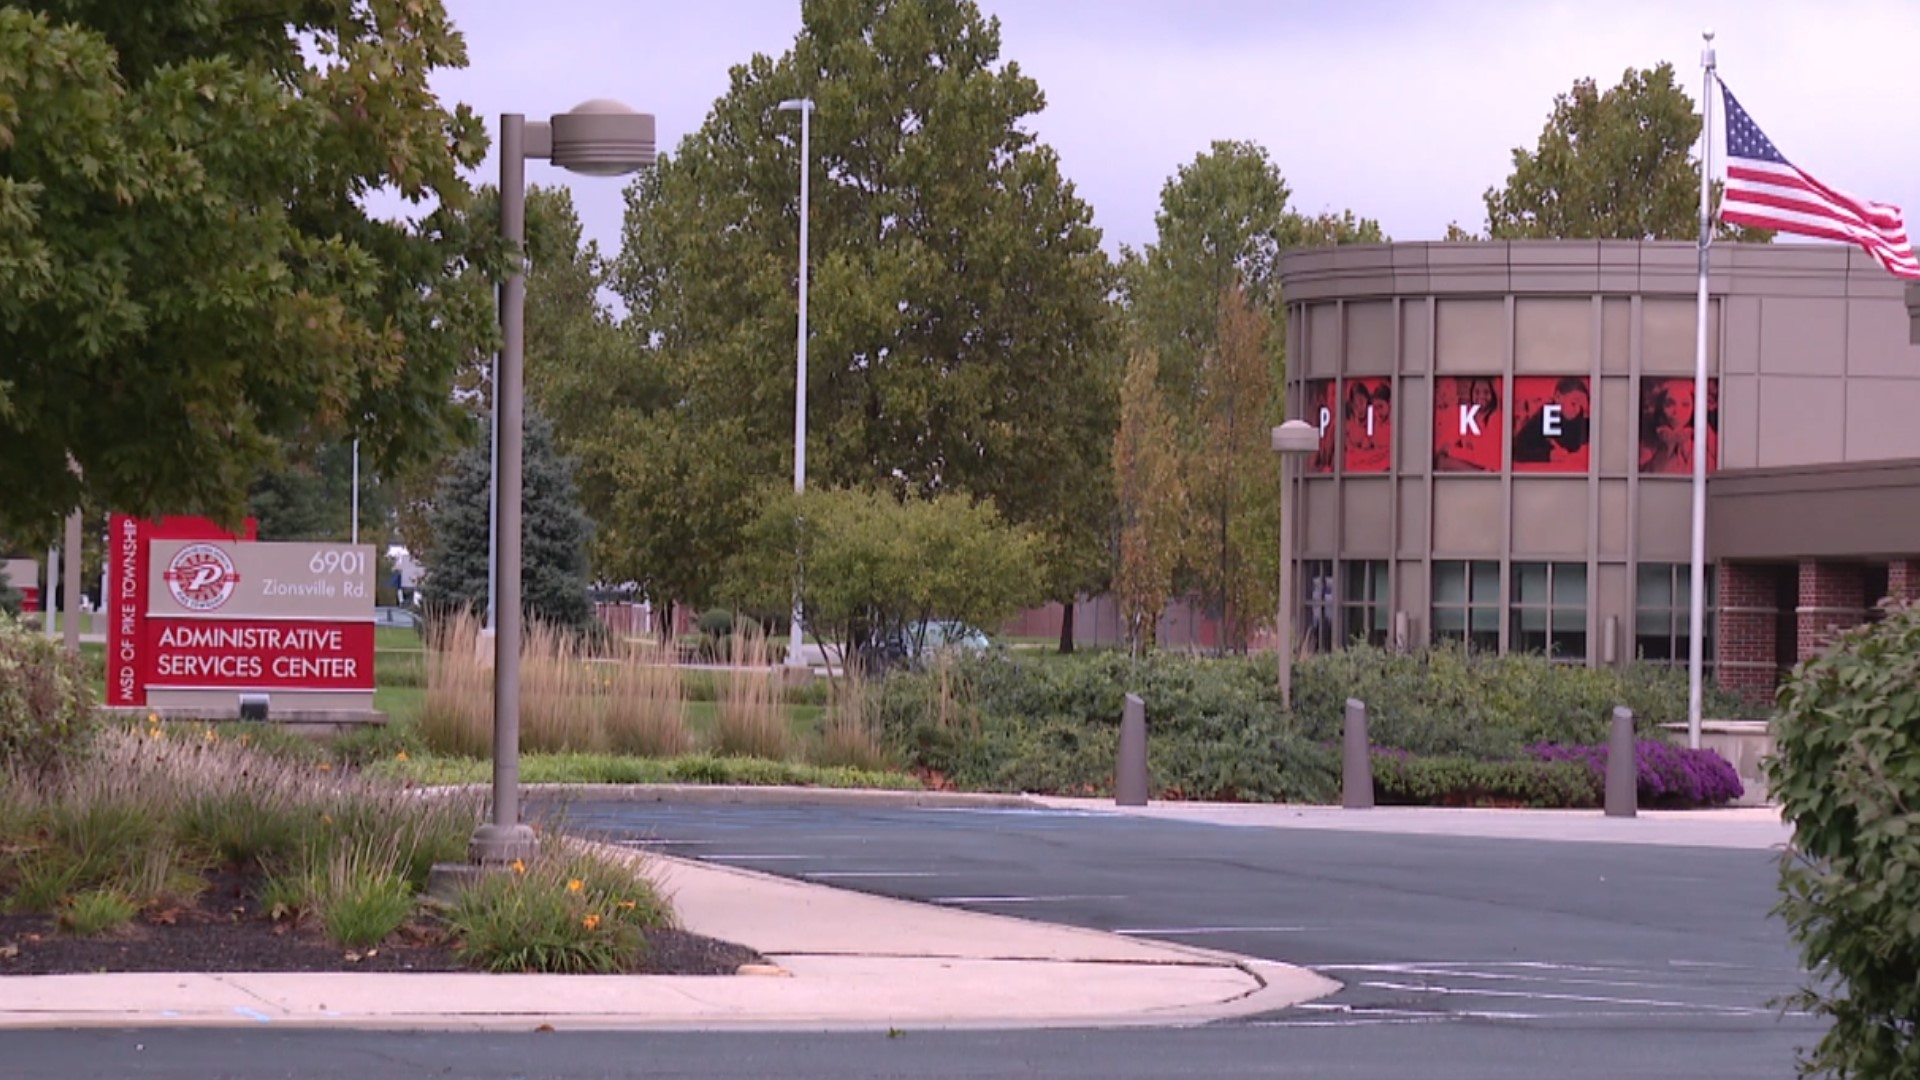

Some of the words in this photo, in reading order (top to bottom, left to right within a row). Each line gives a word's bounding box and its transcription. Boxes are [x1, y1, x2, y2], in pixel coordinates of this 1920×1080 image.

[1318, 404, 1563, 437] PIKE
[122, 519, 138, 599] TOWNSHIP
[309, 551, 365, 574] 6901
[262, 579, 336, 598] Zionsville
[343, 581, 368, 598] Rd.
[121, 604, 136, 636] PIKE
[120, 639, 135, 658] OF
[158, 627, 343, 650] ADMINISTRATIVE
[157, 654, 263, 677] SERVICES
[271, 656, 357, 678] CENTER
[120, 666, 135, 701] MSD
